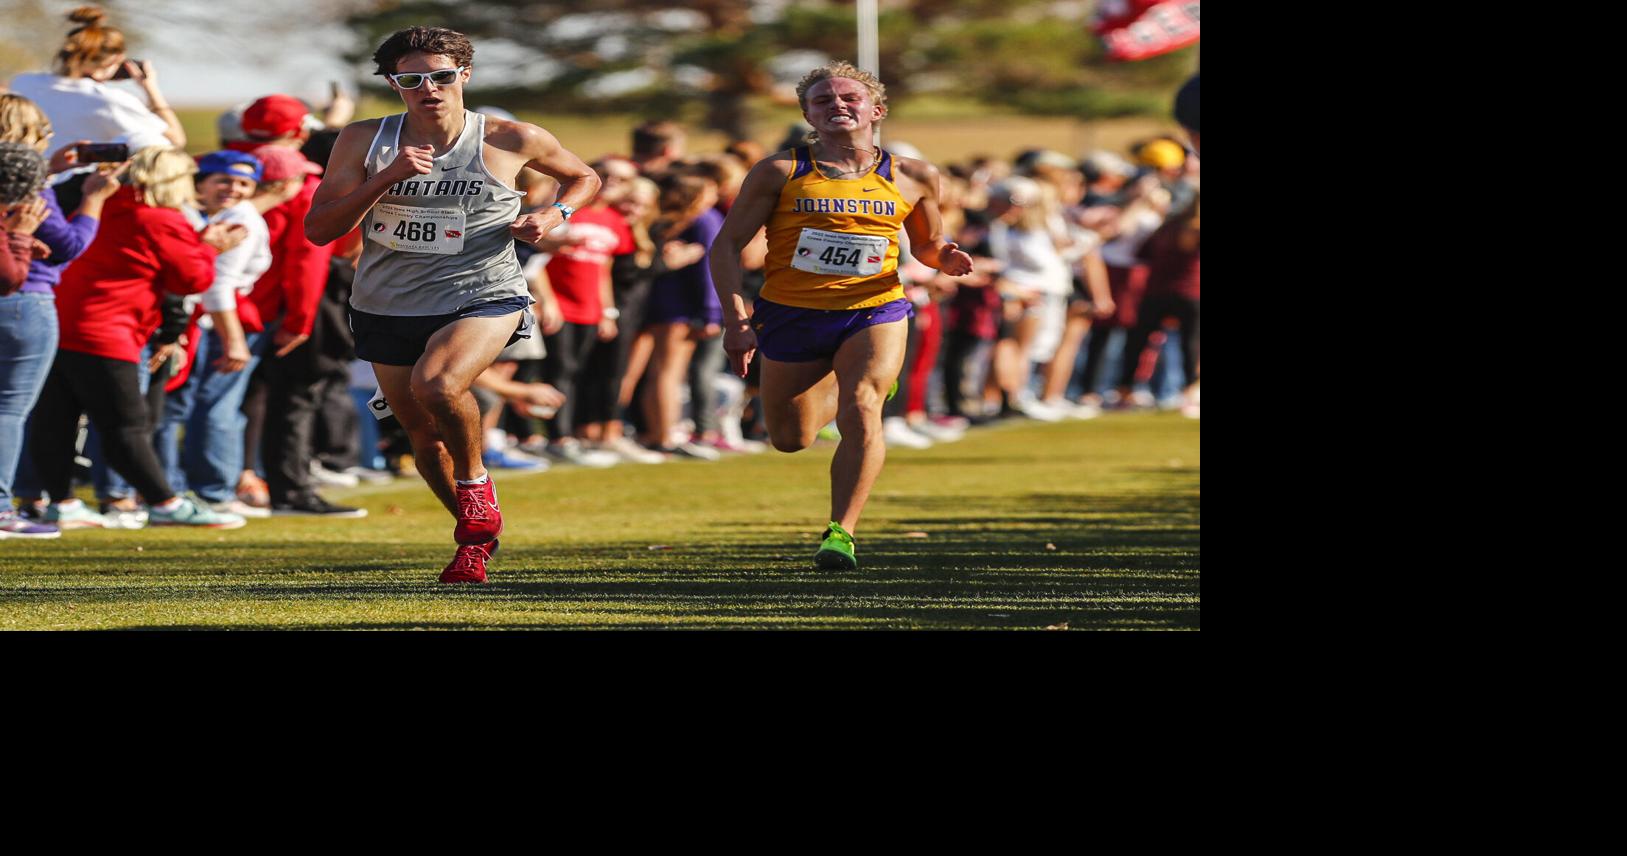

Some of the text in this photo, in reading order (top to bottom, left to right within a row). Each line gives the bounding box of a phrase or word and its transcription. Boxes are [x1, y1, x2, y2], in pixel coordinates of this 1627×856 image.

[388, 180, 484, 196] ARTANS
[792, 198, 896, 216] JOHNSTON
[393, 220, 437, 242] 468
[819, 246, 862, 267] 454
